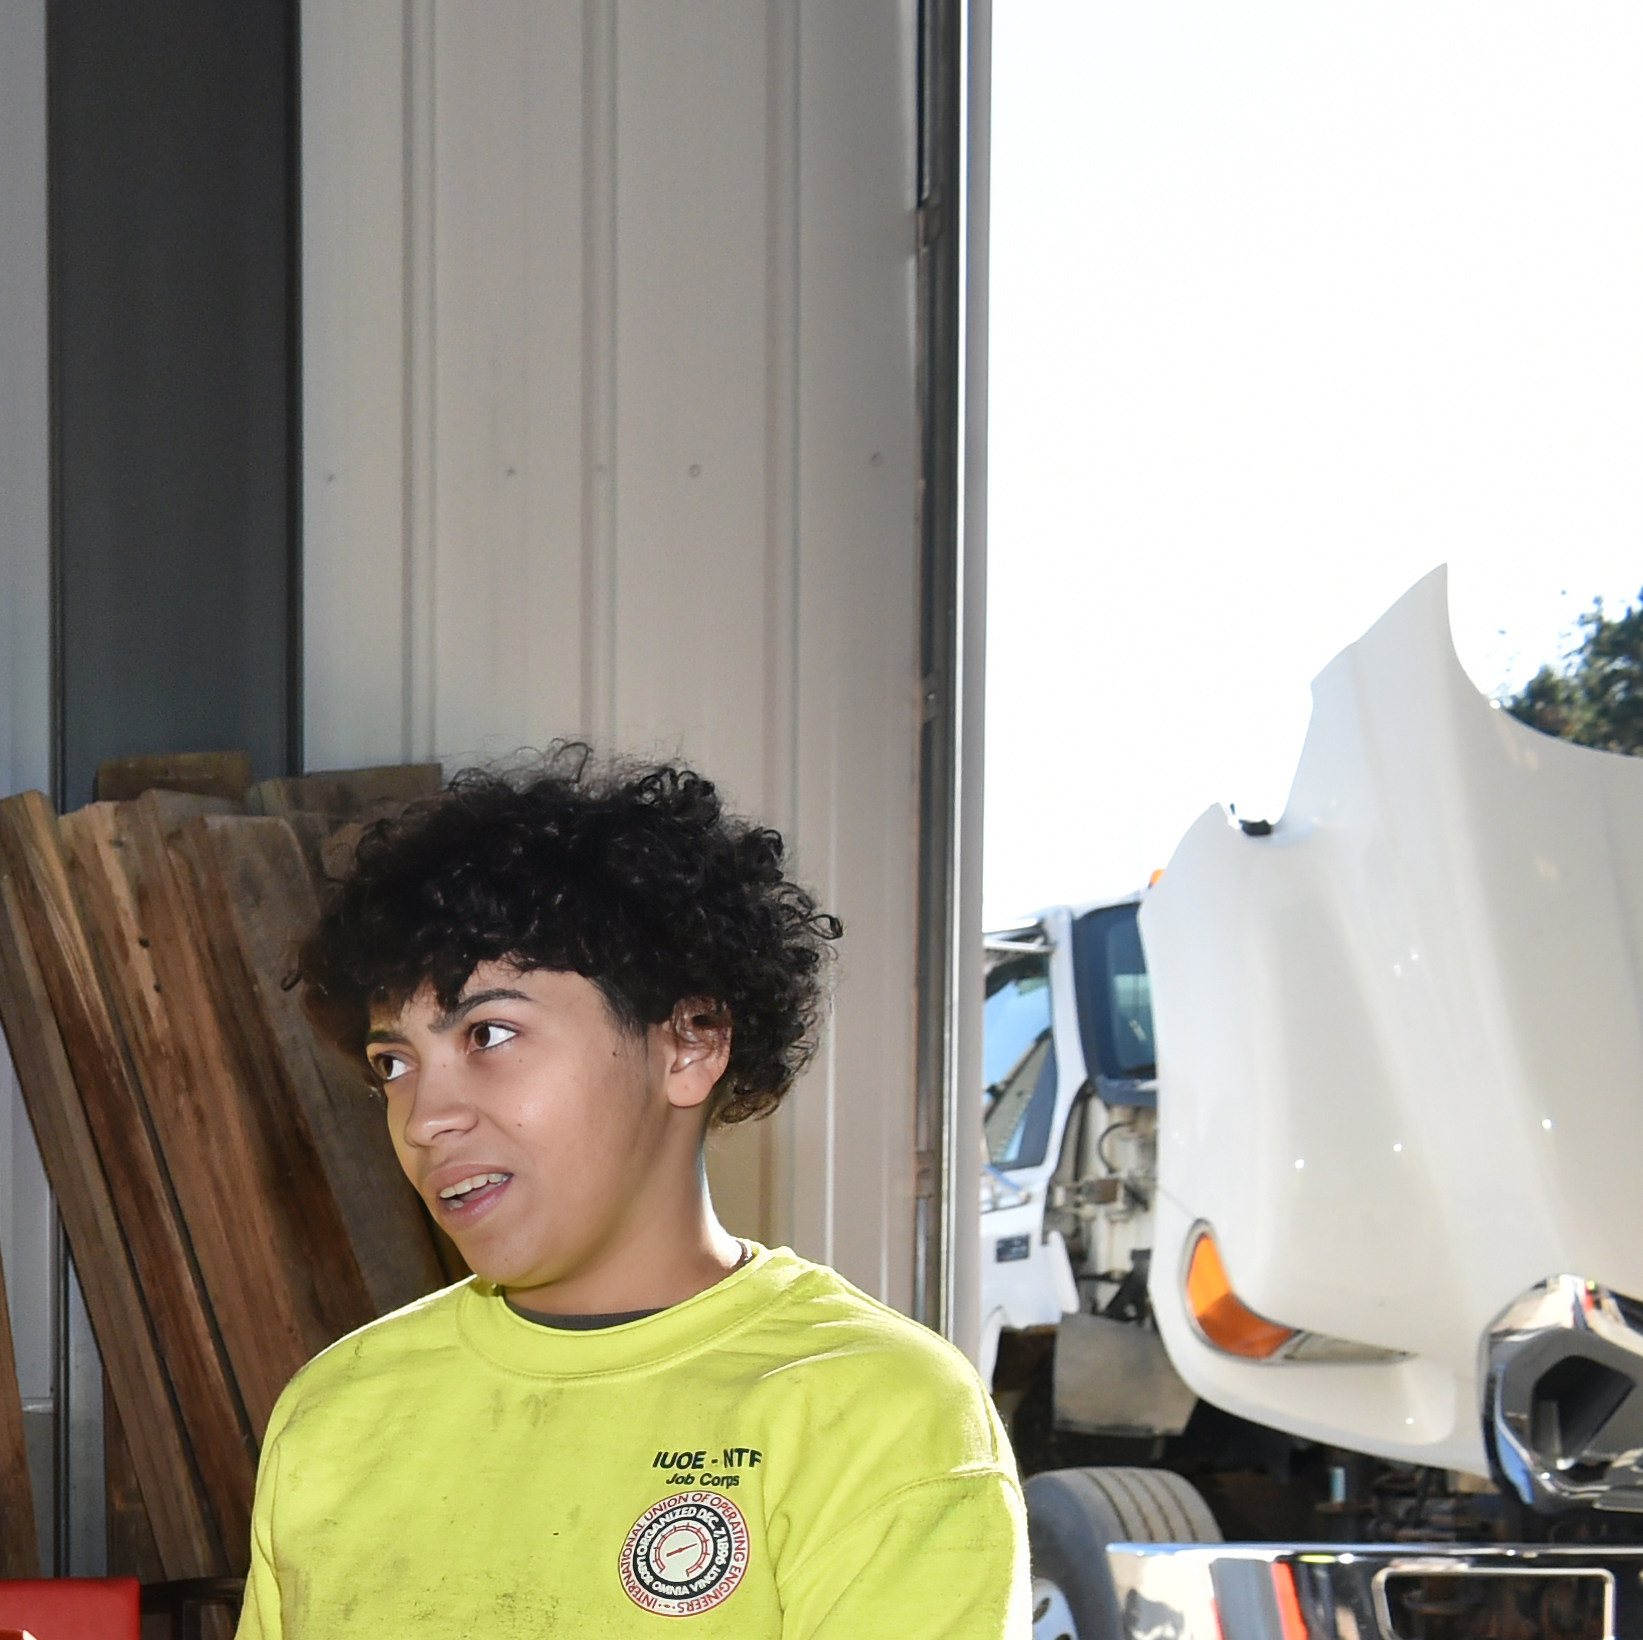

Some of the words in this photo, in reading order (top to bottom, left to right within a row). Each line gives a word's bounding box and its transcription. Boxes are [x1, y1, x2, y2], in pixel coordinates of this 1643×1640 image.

[652, 1450, 706, 1470] IUOE
[723, 1448, 763, 1469] NTF
[665, 1473, 695, 1486] Job
[699, 1474, 740, 1490] Corps
[692, 1492, 712, 1503] OF
[644, 1494, 689, 1522] UNION
[636, 1506, 697, 1556] ORGANIZED
[716, 1537, 729, 1566] 1896
[710, 1496, 746, 1563] OPERATING
[620, 1523, 658, 1609] INTERNATIONAL
[677, 1565, 741, 1613] ENGINEERS
